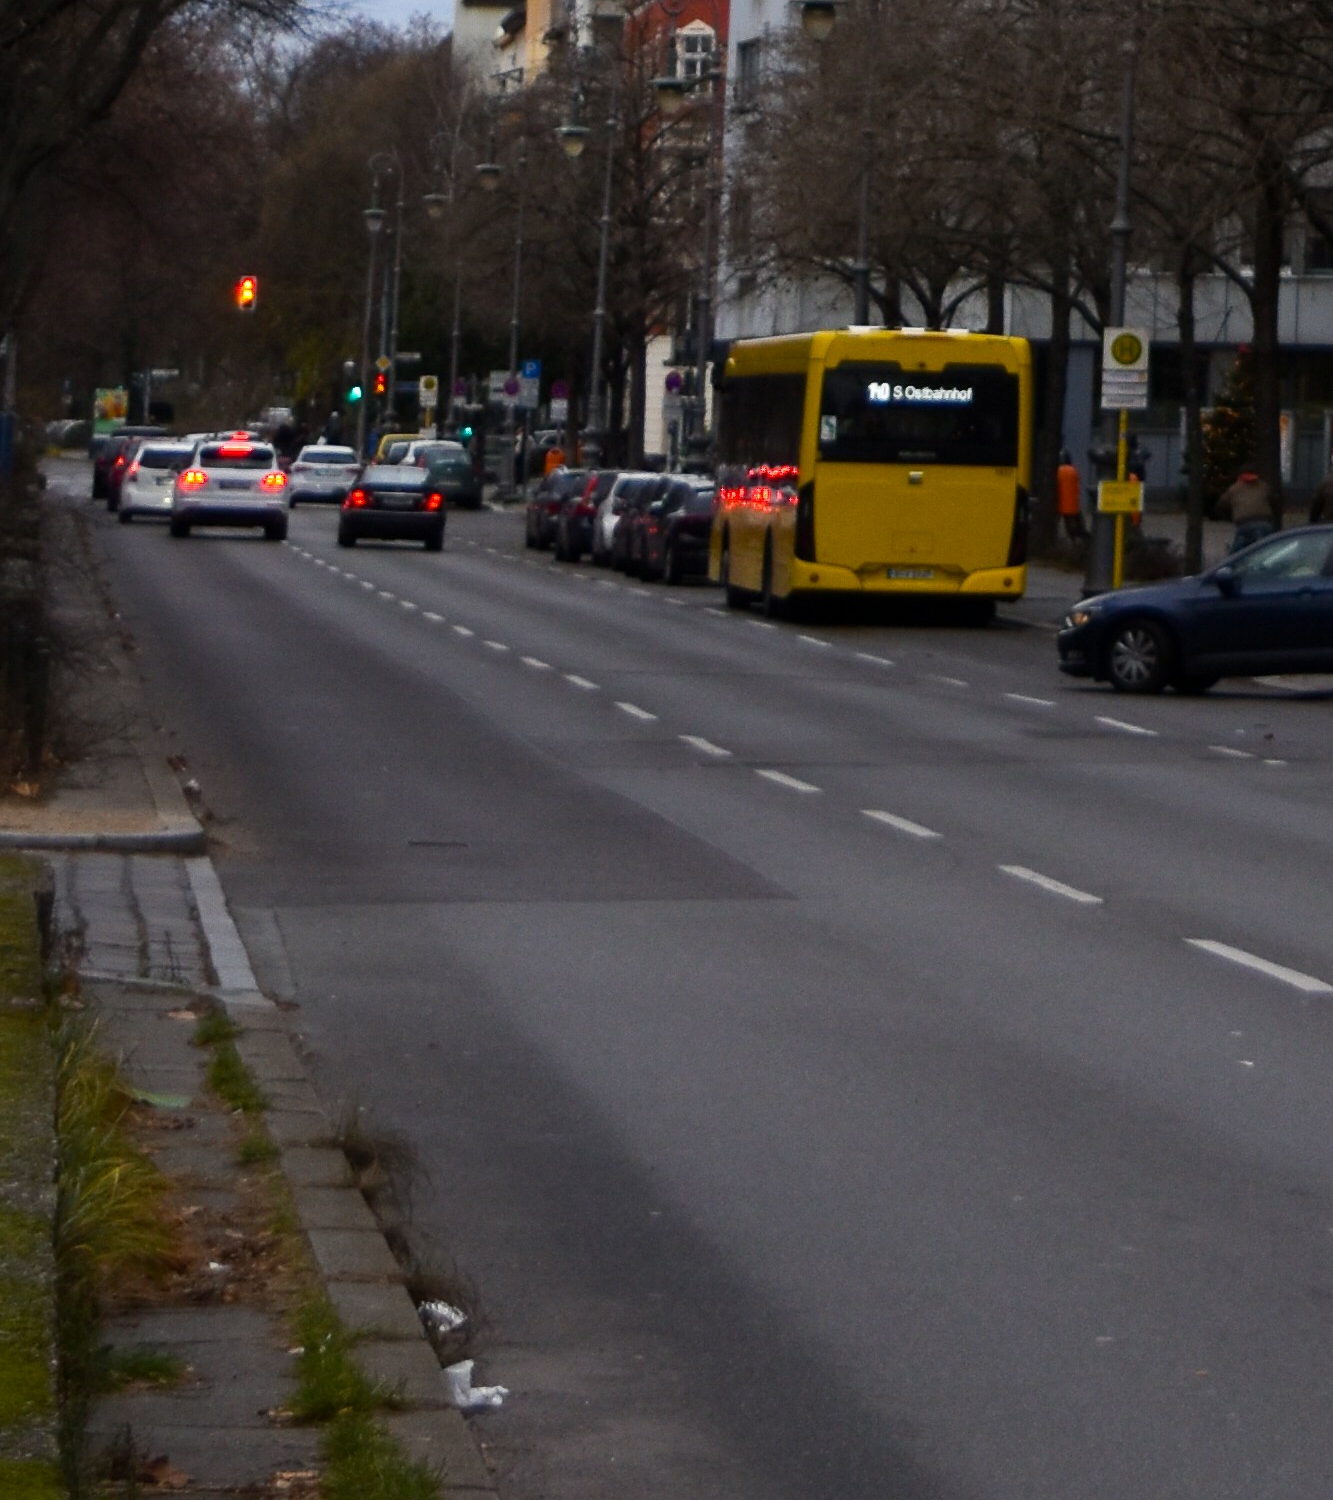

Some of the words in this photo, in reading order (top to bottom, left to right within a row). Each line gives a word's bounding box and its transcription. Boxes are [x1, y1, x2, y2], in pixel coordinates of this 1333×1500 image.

[526, 363, 536, 374] P
[892, 385, 903, 400] S
[904, 385, 973, 401] Ostbahnhof
